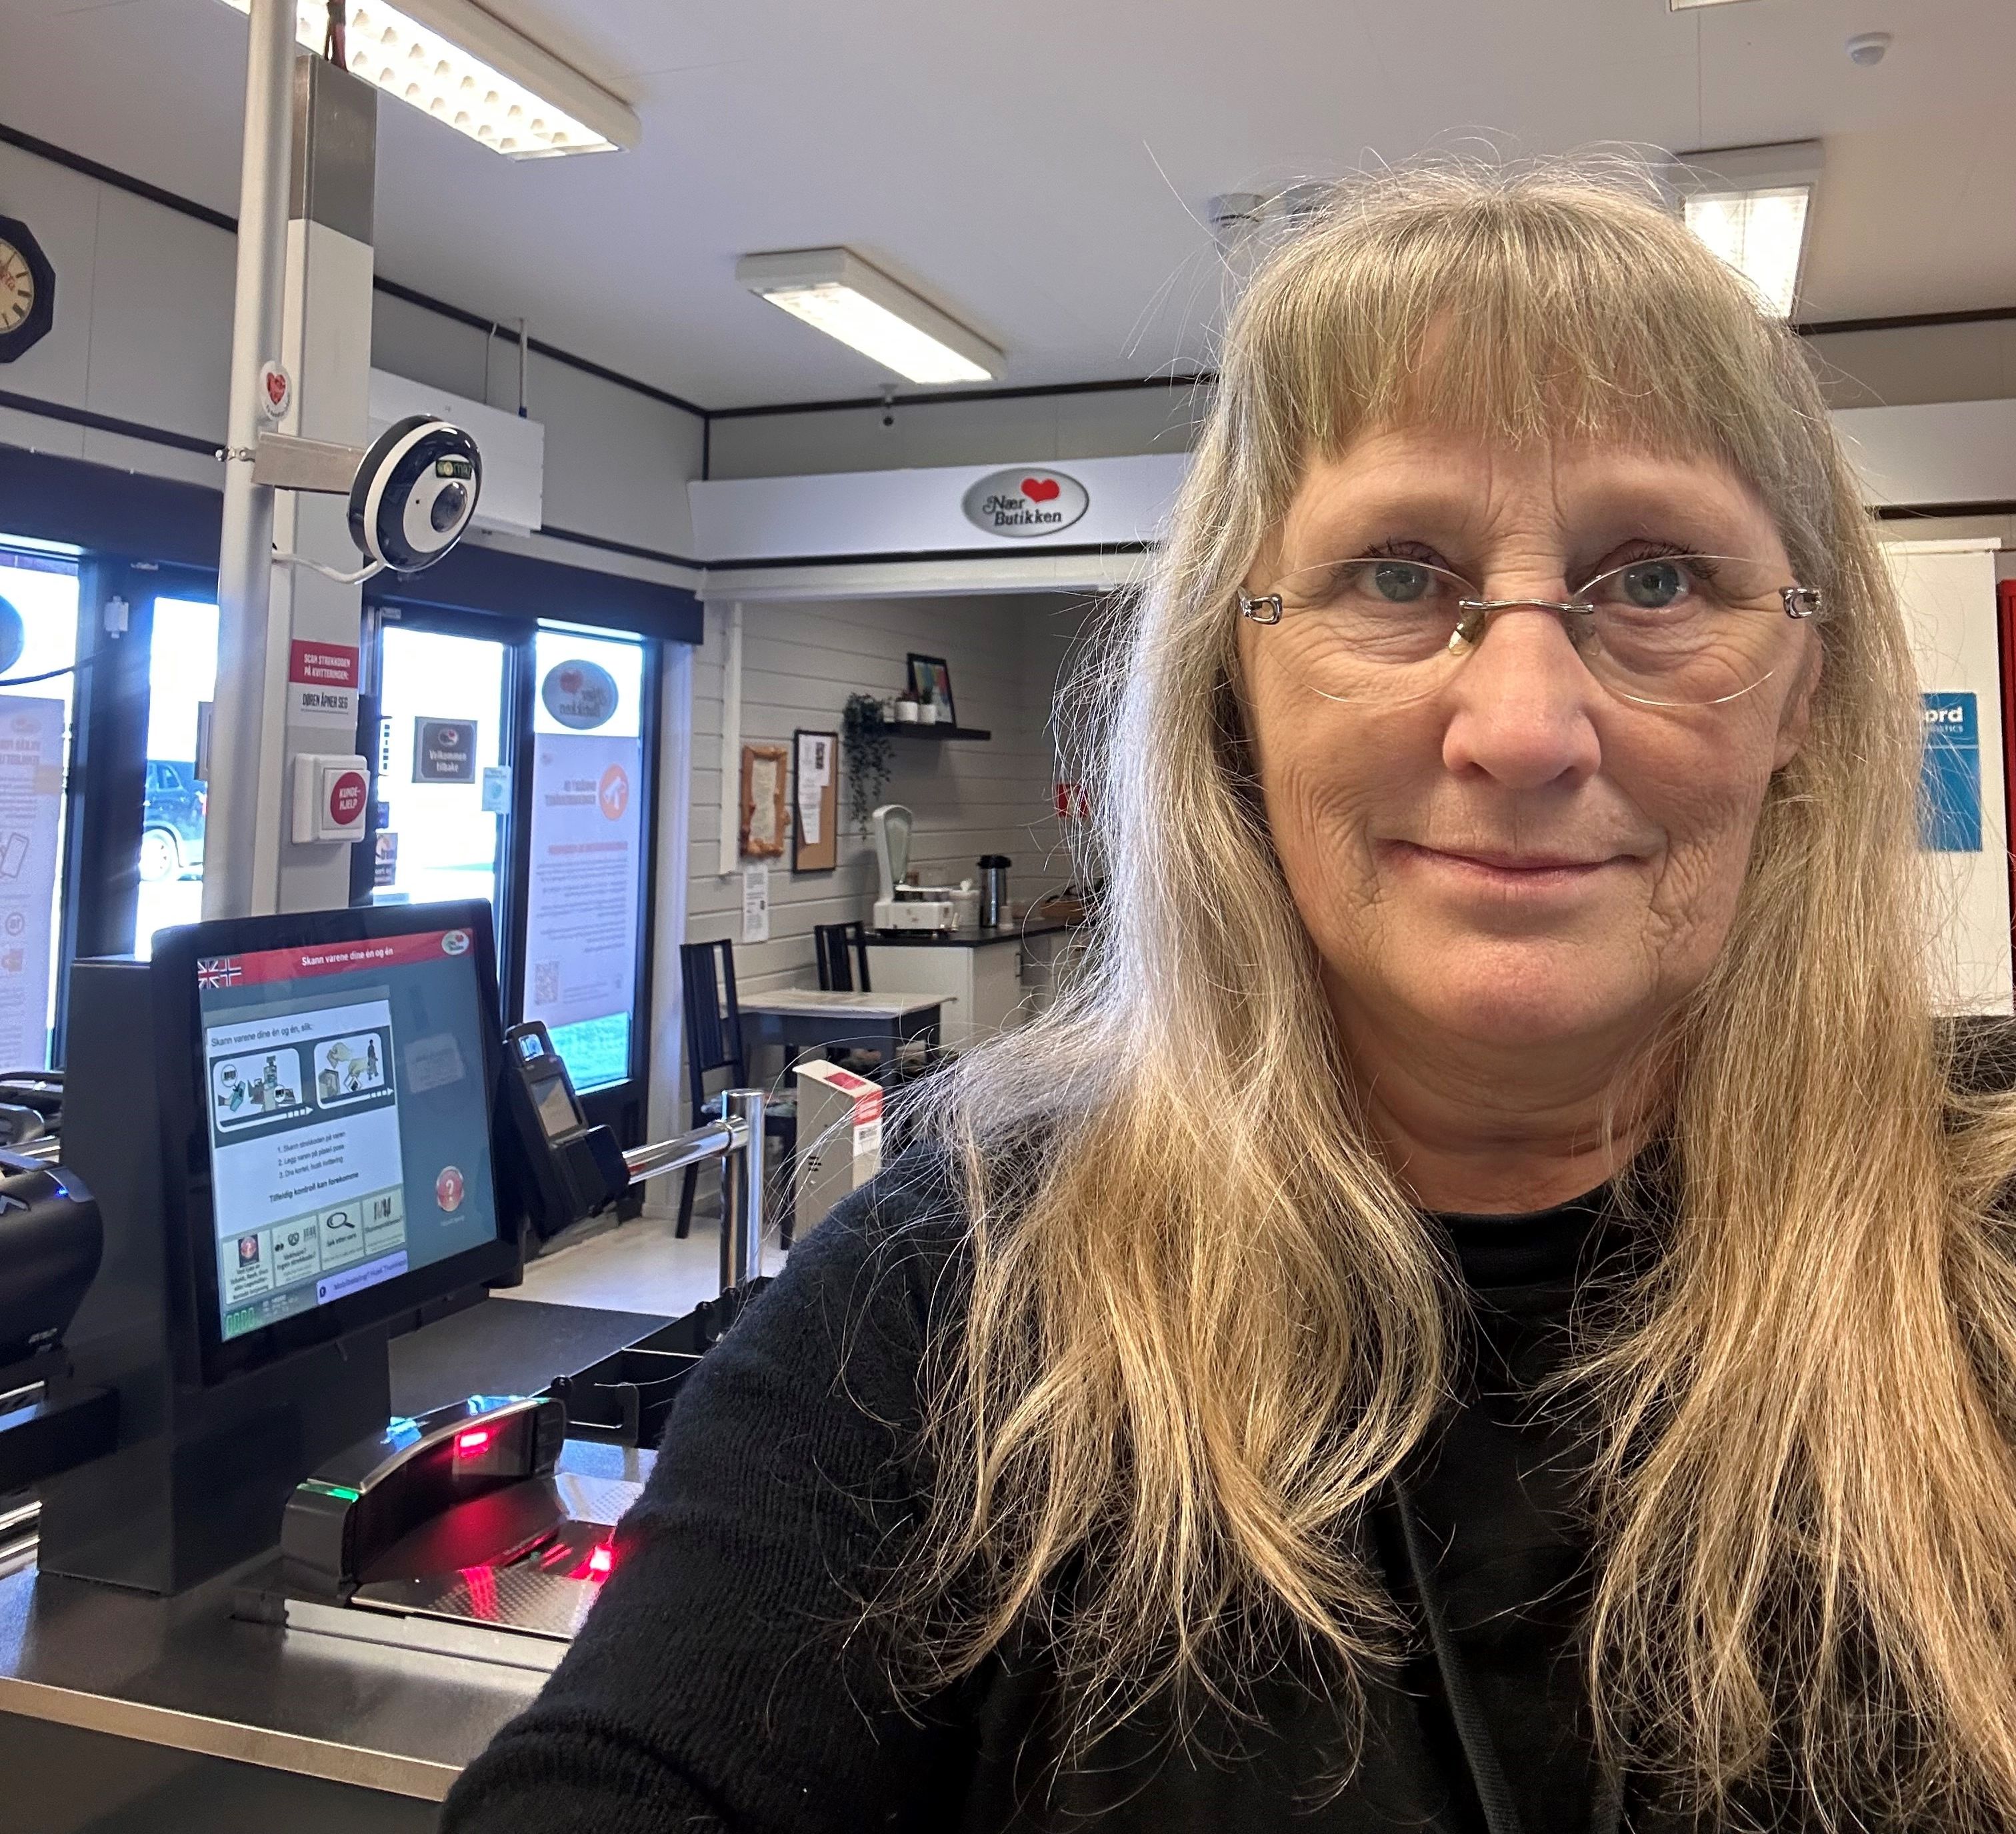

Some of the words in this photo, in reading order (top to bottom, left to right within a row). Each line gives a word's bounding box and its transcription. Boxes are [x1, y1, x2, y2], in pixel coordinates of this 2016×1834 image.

[983, 495, 1025, 514] Nær
[994, 509, 1062, 526] Butikken
[304, 664, 311, 676] PÅ
[302, 693, 320, 707] DØREN
[321, 691, 337, 708] ÅPNER
[338, 696, 348, 709] SEG
[1925, 706, 1963, 723] ord
[429, 749, 467, 761] Velkommen
[436, 761, 459, 773] tilbake
[339, 787, 361, 799] KUNDE-
[339, 799, 358, 810] HJELP
[301, 955, 324, 966] Skann
[325, 953, 349, 964] varene
[349, 949, 365, 960] dine
[365, 947, 375, 958] én
[375, 949, 384, 959] og
[385, 946, 393, 956] én
[211, 1036, 232, 1047] Skann
[234, 1033, 255, 1043] varene
[257, 1030, 270, 1039] dine
[272, 1027, 280, 1037] én
[281, 1027, 289, 1037] og
[294, 1183, 316, 1195] kontroll
[317, 1181, 327, 1189] kan
